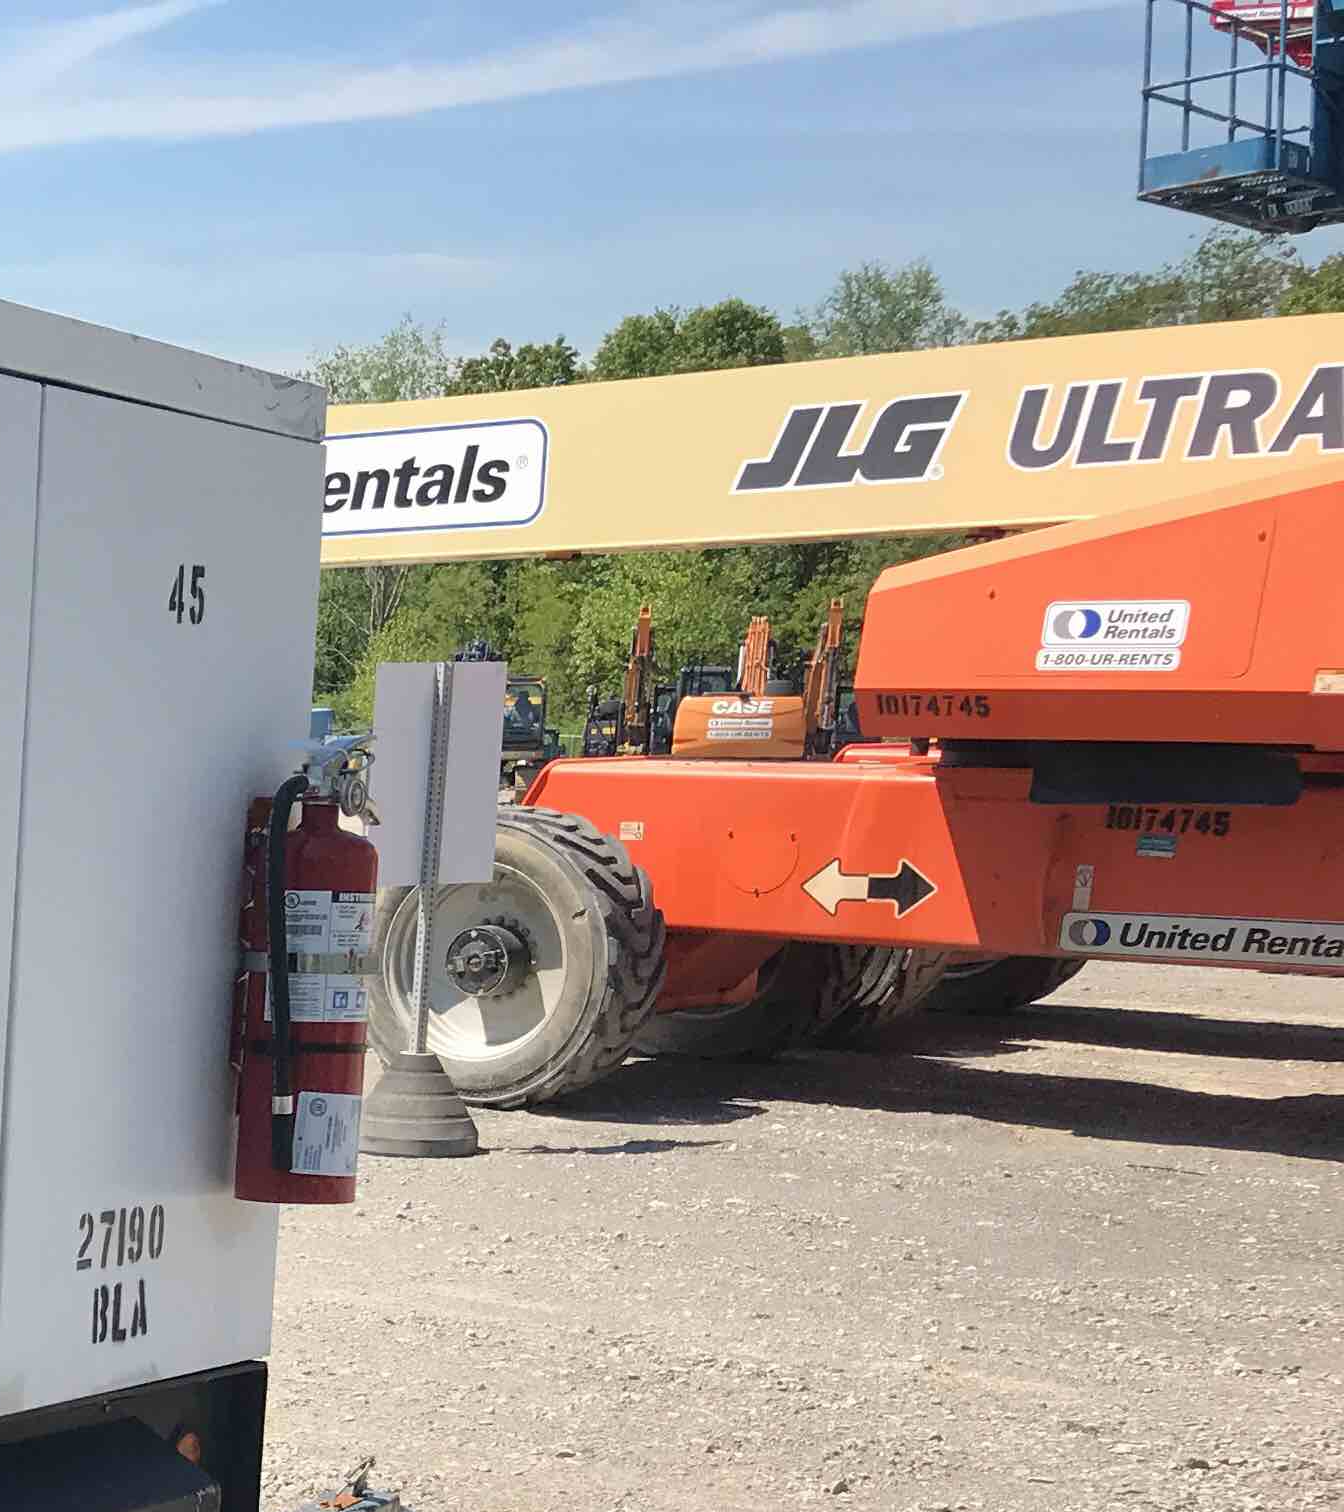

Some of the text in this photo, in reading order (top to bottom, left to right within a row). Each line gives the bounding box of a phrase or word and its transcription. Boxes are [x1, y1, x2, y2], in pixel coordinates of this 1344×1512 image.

[734, 364, 1344, 491] JLG ULTRA
[169, 564, 205, 625] 45
[1103, 625, 1177, 640] Rentals
[1107, 608, 1175, 624] United
[1042, 653, 1175, 666] 1-800-UR-RENTS
[712, 699, 775, 715] CASE
[1119, 922, 1344, 958] United Renta
[76, 1204, 165, 1271] 27190
[92, 1278, 148, 1345] BLA
